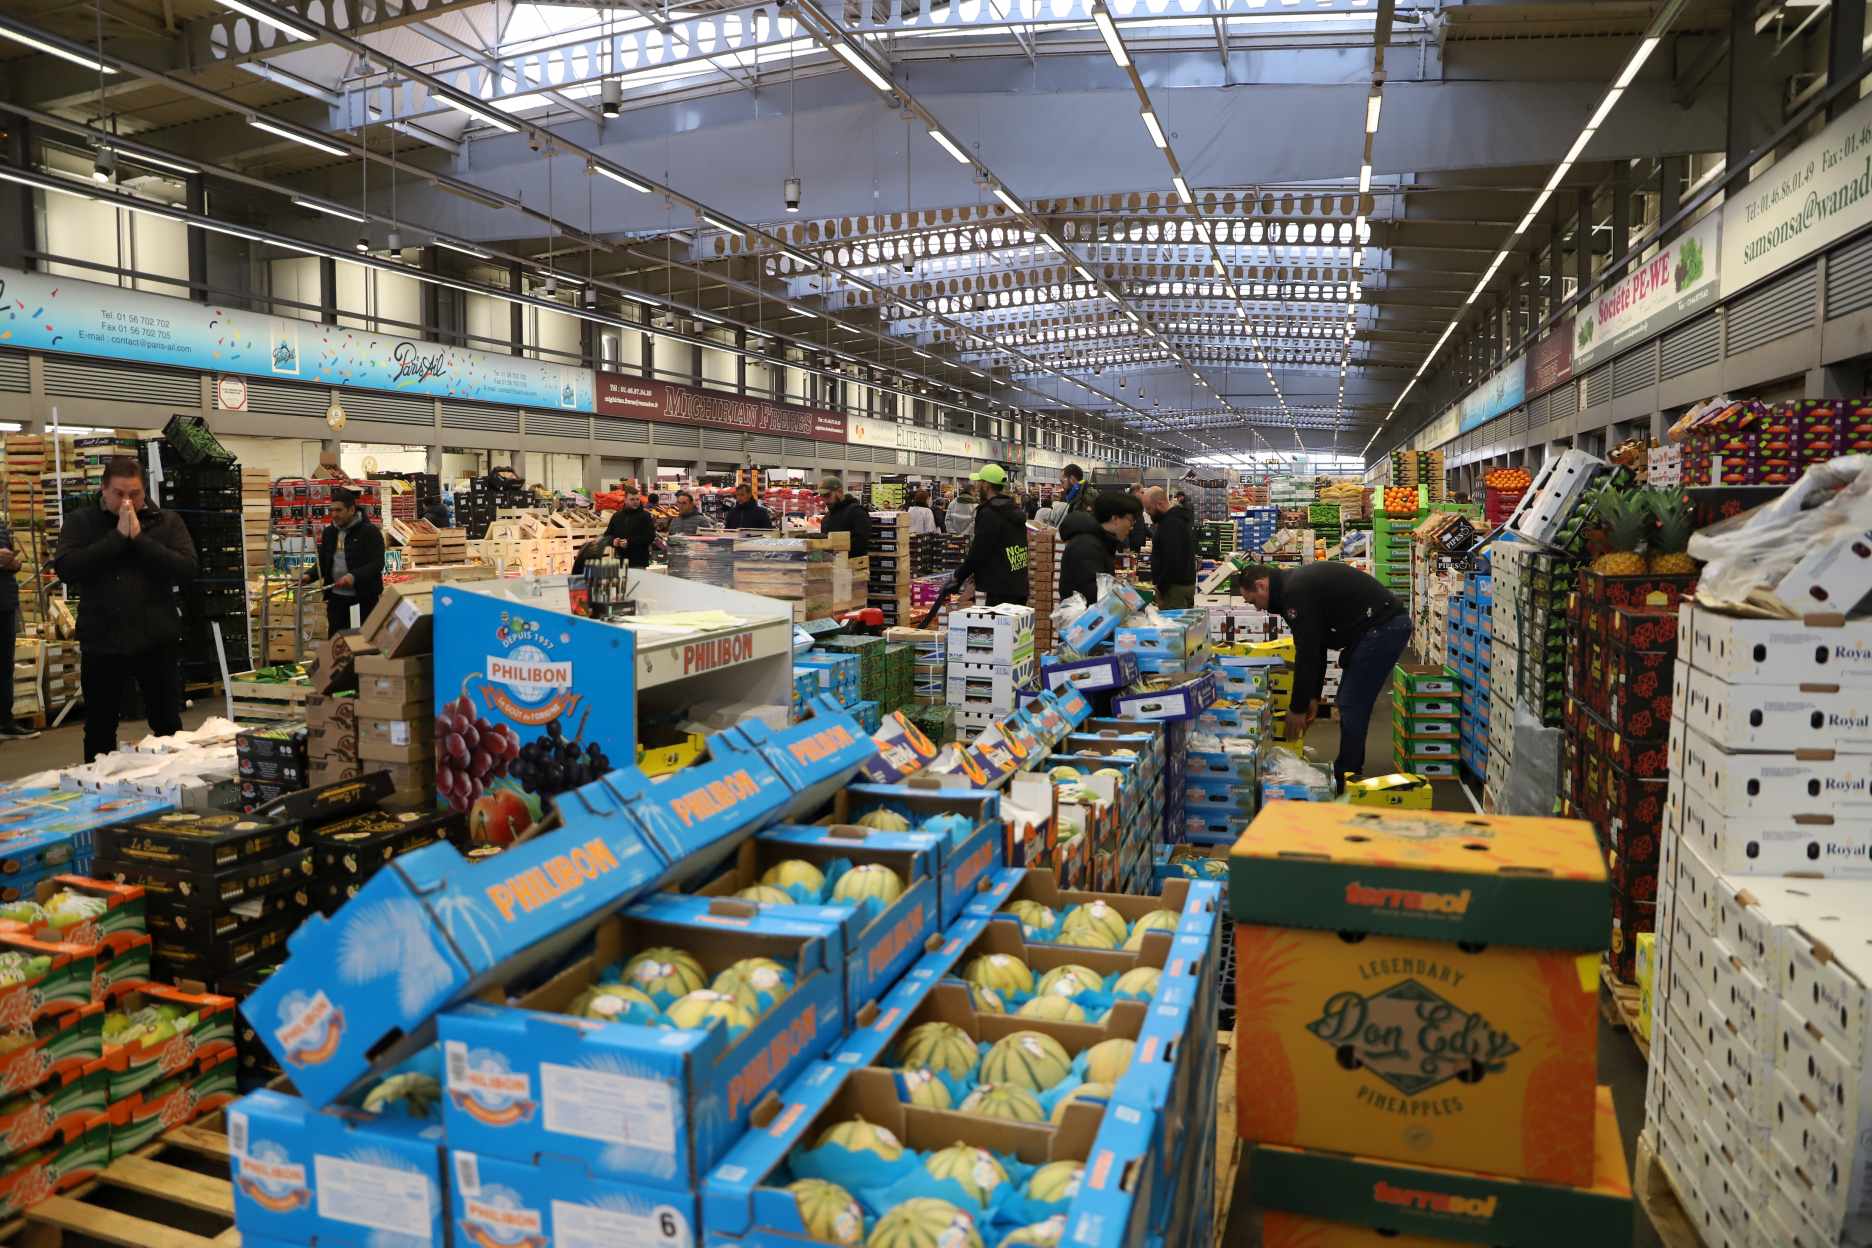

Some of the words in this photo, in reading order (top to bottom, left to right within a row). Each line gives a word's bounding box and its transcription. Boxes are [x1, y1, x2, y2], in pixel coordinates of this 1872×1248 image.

[1744, 154, 1872, 264] samsonsa@wanad
[502, 631, 532, 648] DEPUIS
[684, 633, 753, 675] PHILIBON
[1835, 646, 1872, 662] Roya
[491, 663, 567, 683] PHILIBON
[1828, 713, 1869, 730] Royal
[671, 769, 760, 828] PHILIBON
[1825, 777, 1865, 793] Royal
[1826, 842, 1866, 858] Royal
[486, 837, 620, 923] PHILIBON
[1359, 957, 1465, 988] LEGENDARY
[1316, 991, 1406, 1057] Don
[1355, 1084, 1464, 1117] PINEAPPLES
[659, 1211, 678, 1238] 6
